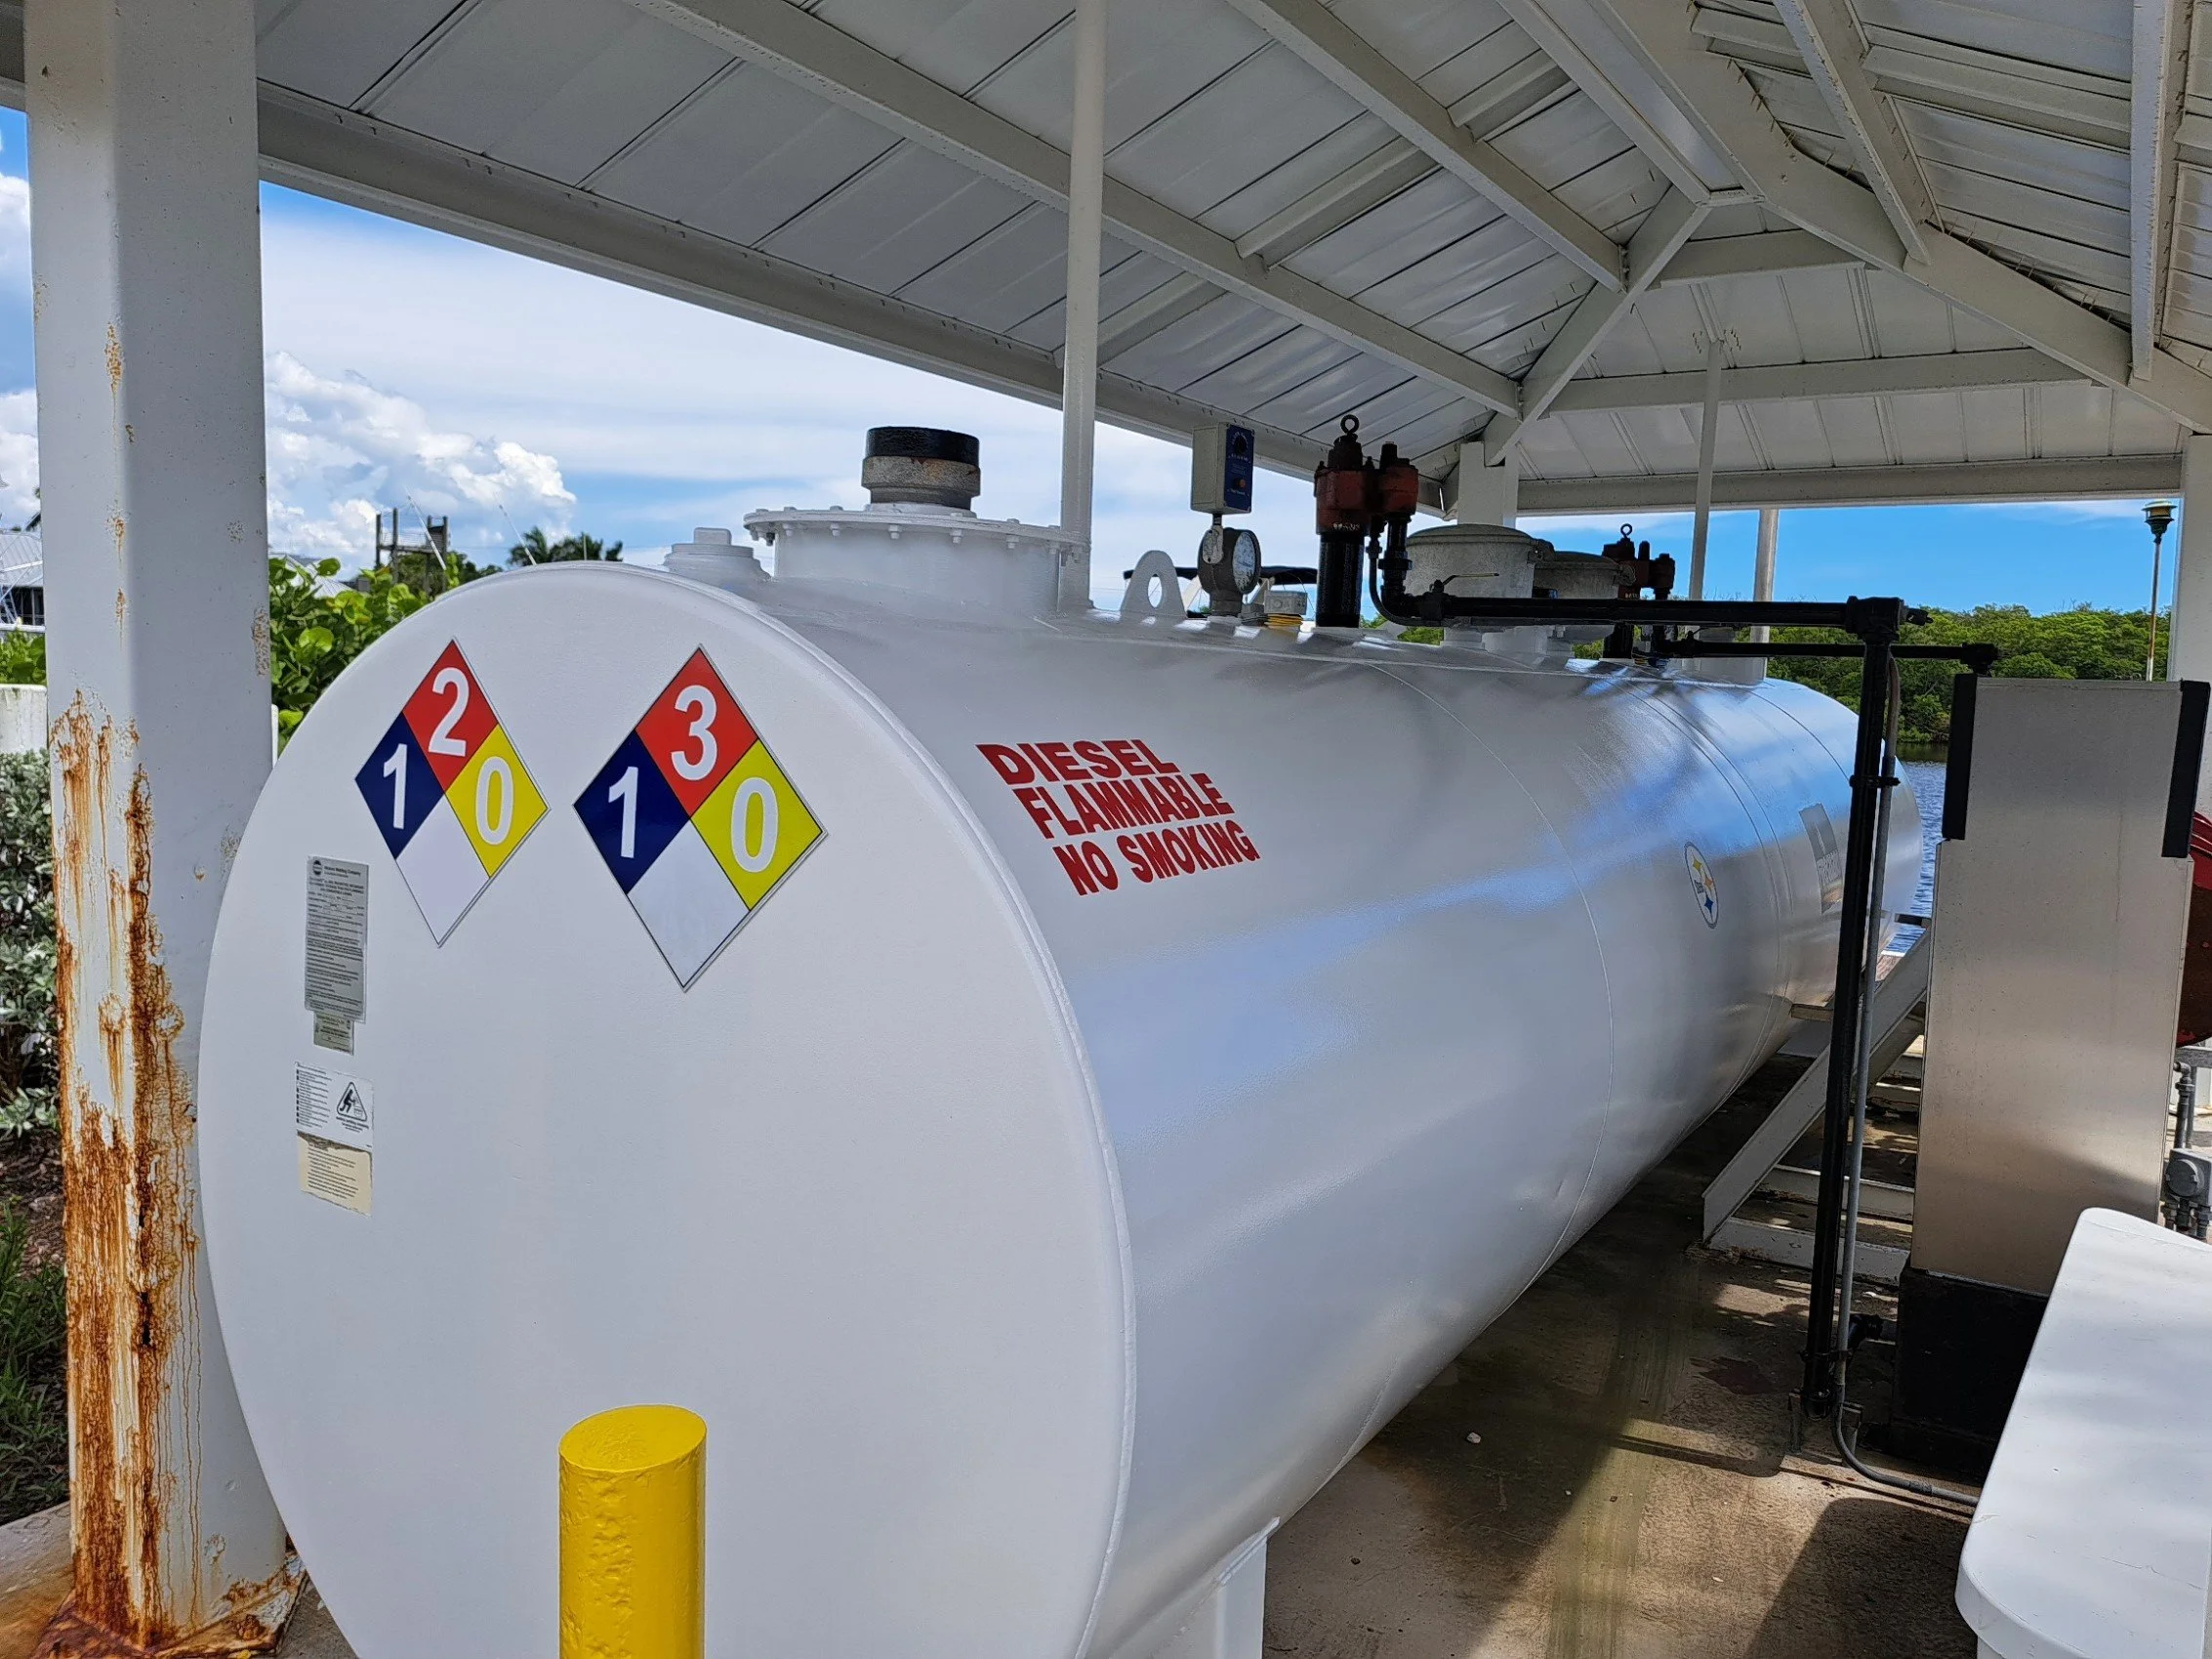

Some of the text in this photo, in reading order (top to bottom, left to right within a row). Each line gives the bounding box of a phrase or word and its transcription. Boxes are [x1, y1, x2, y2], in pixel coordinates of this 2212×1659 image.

[429, 667, 469, 756] 2
[671, 684, 717, 781] 3
[383, 743, 513, 845] 1 0
[975, 739, 1180, 785] DIESEL
[1011, 772, 1235, 840] FLAMMABLE
[608, 766, 778, 872] 1 0
[1052, 819, 1261, 896] NO SMOKING
